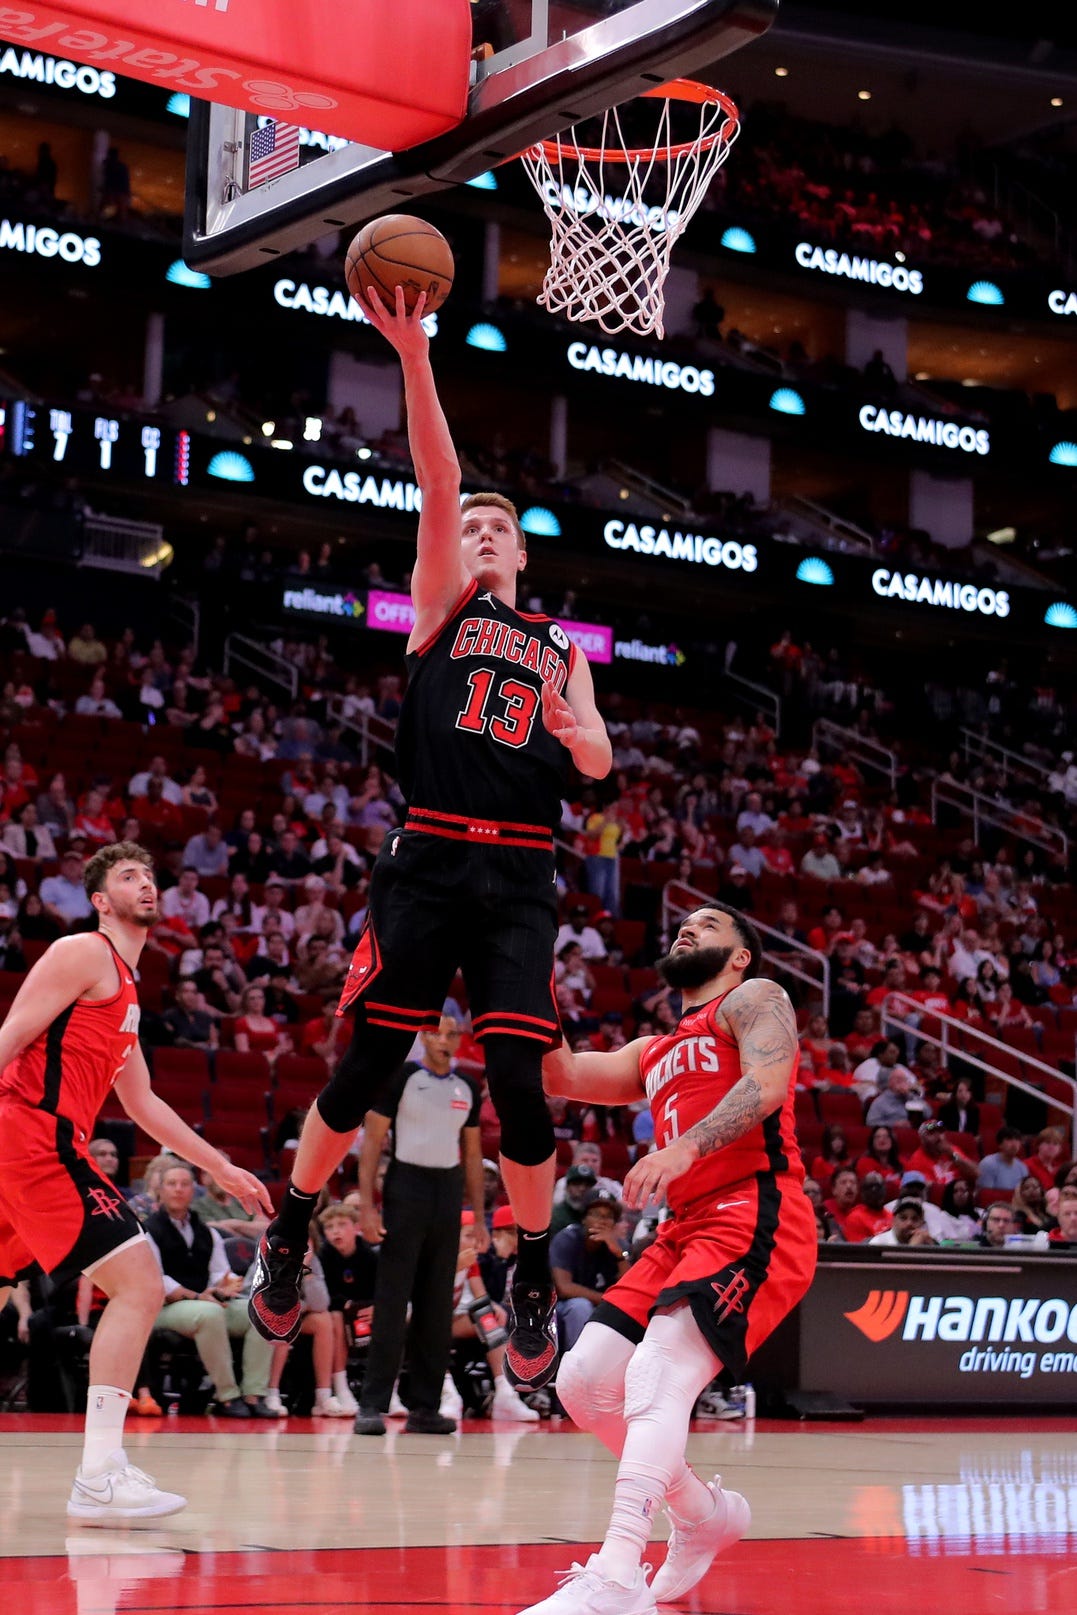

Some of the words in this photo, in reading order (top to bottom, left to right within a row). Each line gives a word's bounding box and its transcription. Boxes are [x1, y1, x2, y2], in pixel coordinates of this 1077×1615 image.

[0, 219, 100, 266] MIGOS
[795, 242, 923, 294] CASAMIGOS
[567, 341, 714, 396] CASAMIGOS
[54, 431, 68, 461] 7
[859, 404, 989, 455] CASAMIGOS
[100, 439, 111, 469] 1
[145, 448, 156, 477] 1
[603, 519, 758, 572] CASAMIGOS
[283, 588, 345, 616] reliant
[872, 568, 1009, 618] CASAMIGOS
[450, 617, 568, 697] CHICAGO
[614, 638, 668, 665] reliant
[455, 667, 541, 749] 13
[959, 1346, 1037, 1379] driving
